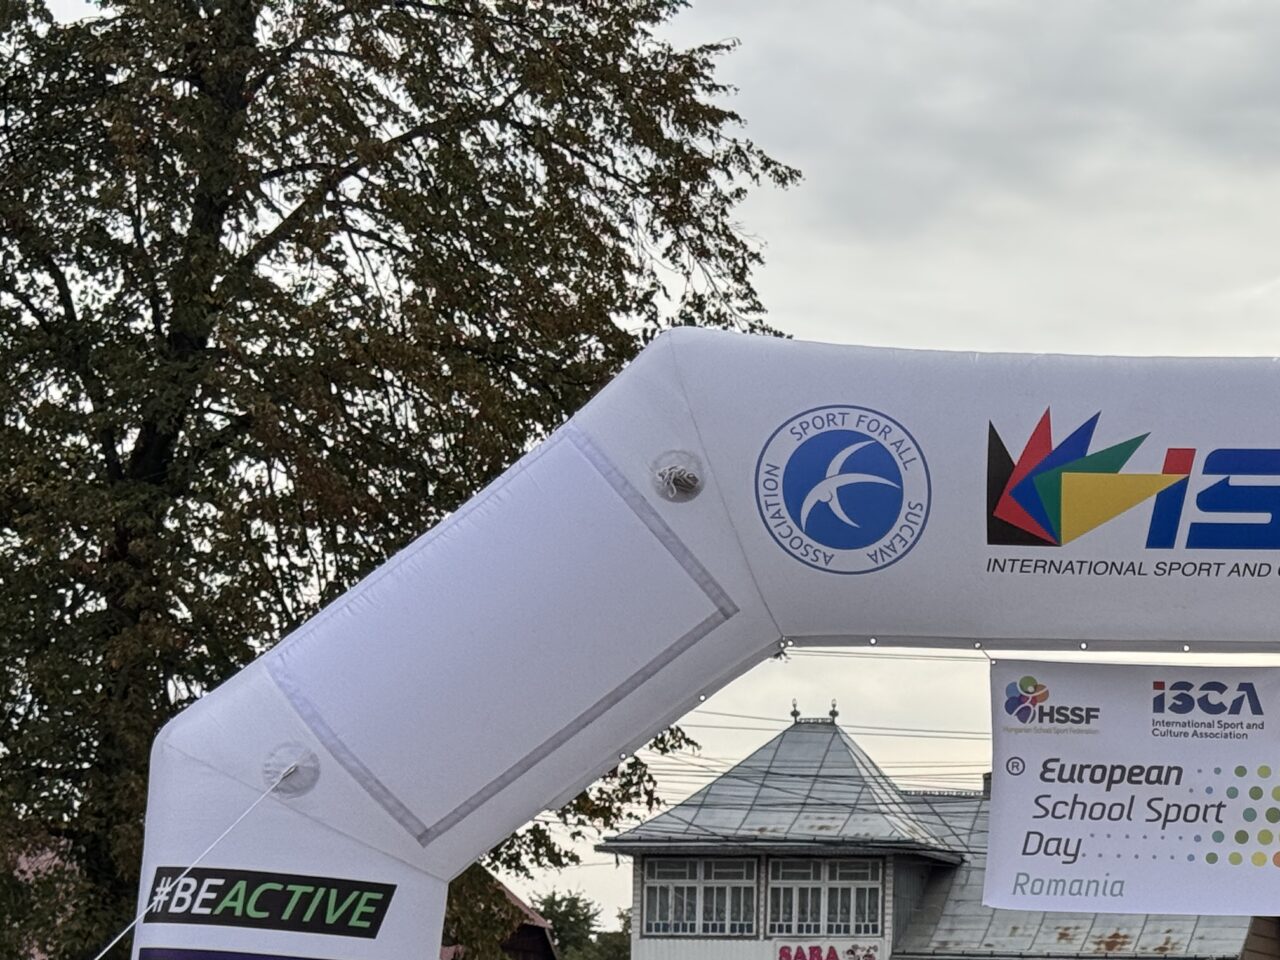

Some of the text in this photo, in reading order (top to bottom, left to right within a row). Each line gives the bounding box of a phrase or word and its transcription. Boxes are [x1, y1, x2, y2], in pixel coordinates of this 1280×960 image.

[790, 412, 917, 471] SPORT FOR ALL
[763, 463, 835, 566] ASSOCIATION
[866, 501, 924, 565] SUCEAVA
[986, 558, 1148, 577] INTERNATIONAL
[1156, 559, 1224, 578] SPORT
[1227, 561, 1272, 578] AND
[1038, 706, 1100, 724] HSSF
[1151, 719, 1264, 732] International Sport and
[1151, 729, 1248, 740] Culture Association
[1039, 758, 1183, 792] European
[1032, 793, 1227, 830] School Sport
[1022, 831, 1082, 865] Day
[1012, 872, 1125, 897] Romania
[152, 877, 384, 929] #BEACTIVE
